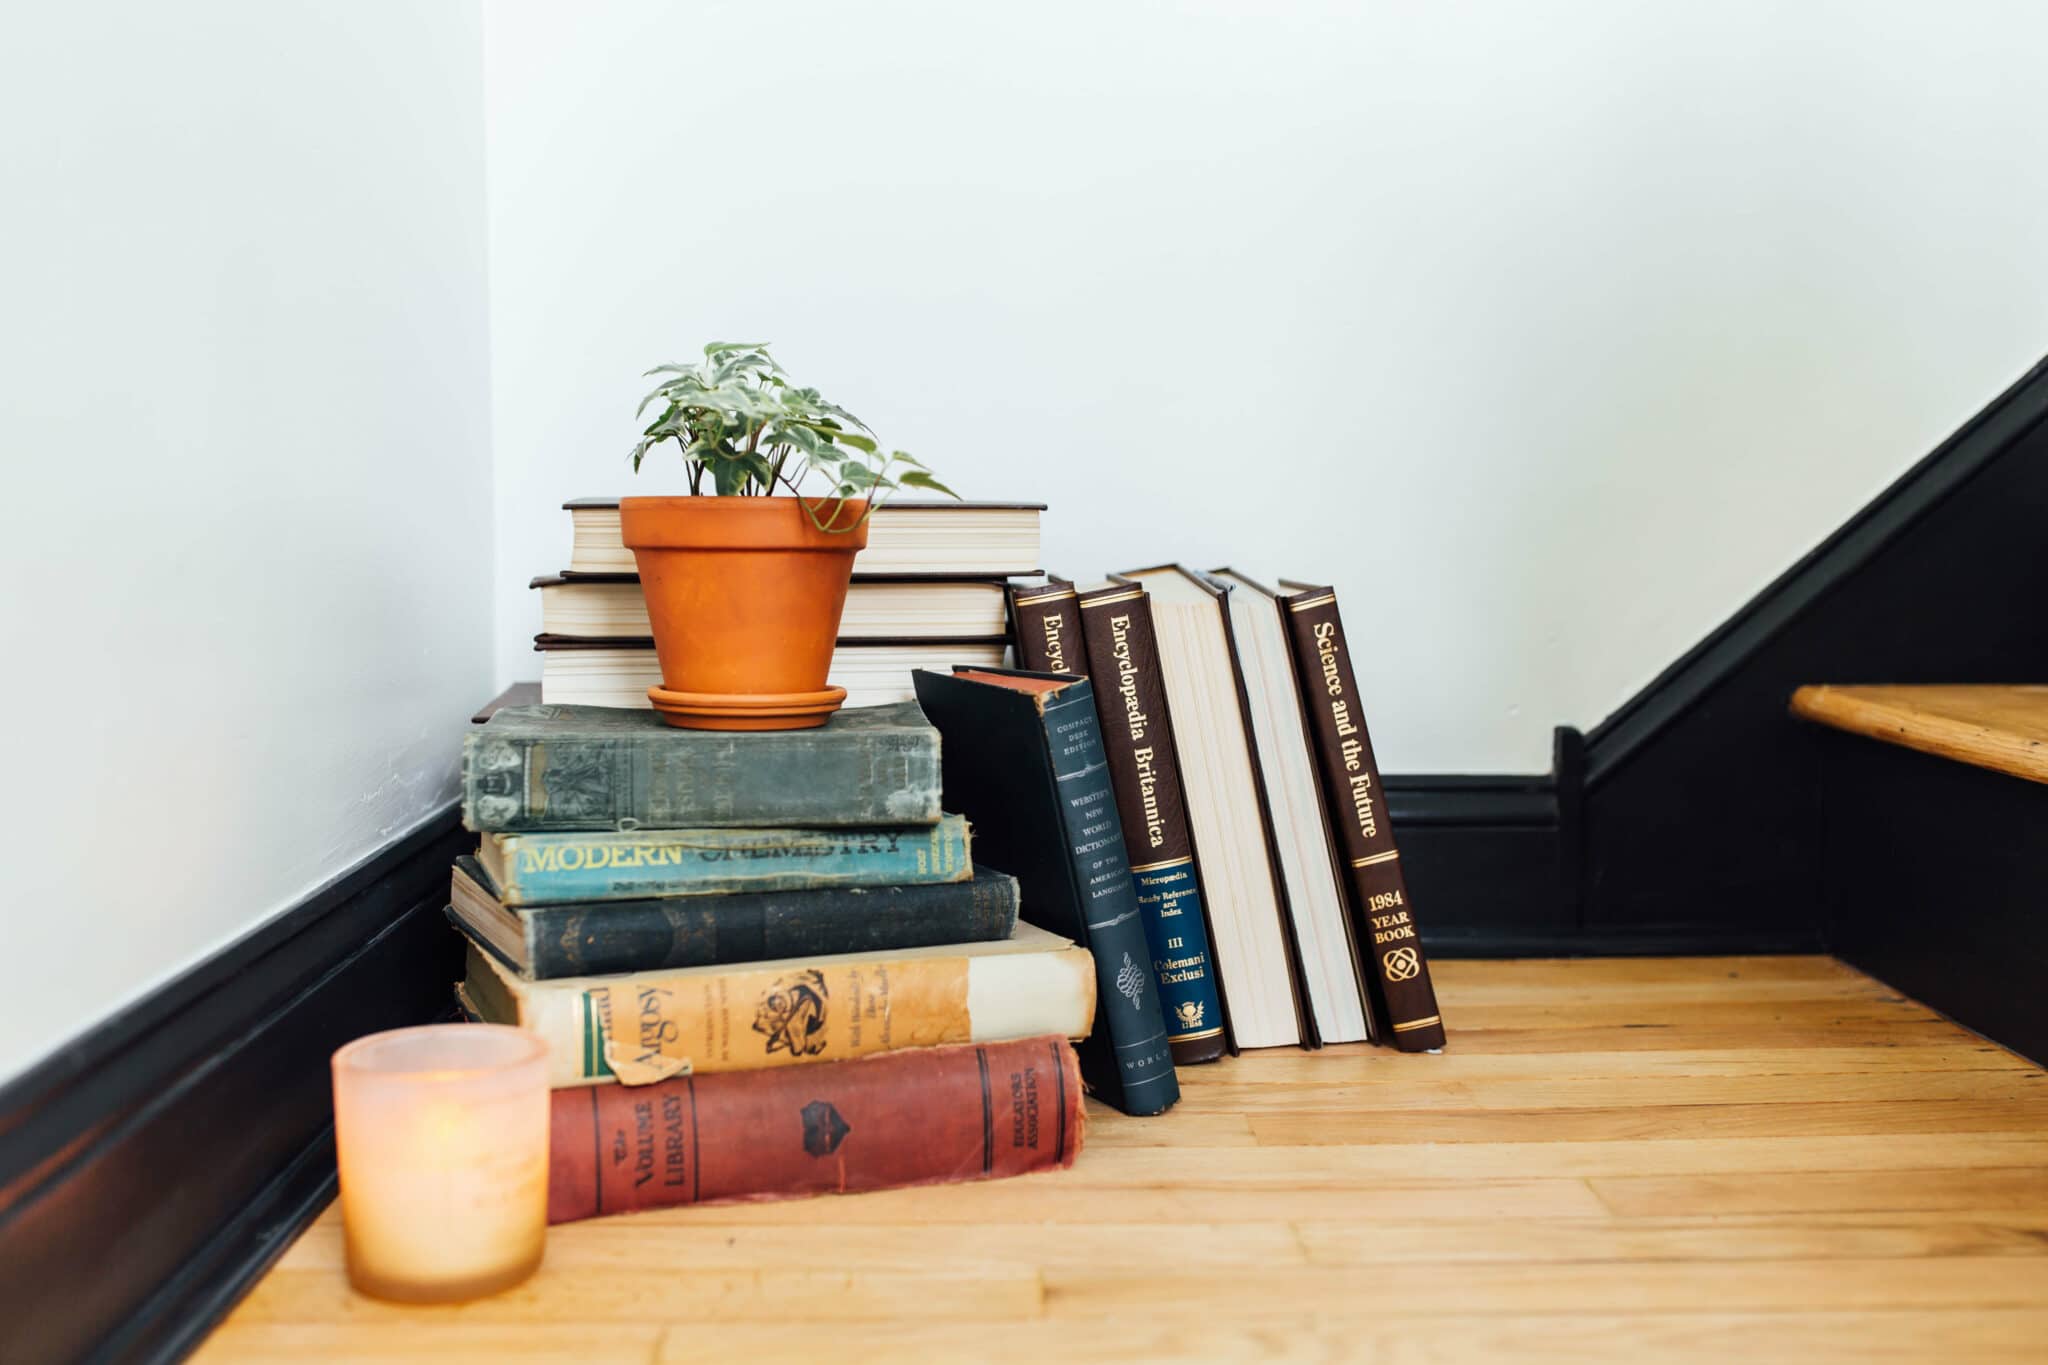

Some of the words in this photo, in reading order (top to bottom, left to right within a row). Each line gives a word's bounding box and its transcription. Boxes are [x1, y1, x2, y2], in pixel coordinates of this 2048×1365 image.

[1314, 622, 1342, 696] Science
[1057, 716, 1093, 733] COMPACT
[1332, 700, 1357, 736] and
[1111, 614, 1148, 741] Encyclopædia
[1134, 746, 1165, 847] Britannica
[1341, 734, 1362, 772] the
[1085, 808, 1104, 820] NEW
[1349, 771, 1377, 839] Future
[1083, 820, 1112, 836] WORLD
[524, 843, 683, 873] MODERN
[1093, 860, 1103, 870] OF
[1162, 899, 1177, 909] and
[1368, 889, 1404, 912] 1984
[1372, 911, 1410, 929] YEAR
[1168, 937, 1184, 949] III
[1375, 925, 1416, 944] BOOK
[1154, 952, 1205, 971] Colemani
[1160, 966, 1205, 984] Exclusi
[633, 985, 679, 1070] Argosy
[1025, 1068, 1038, 1148] ASSOCIATION
[635, 1101, 655, 1188] VOLUME
[663, 1094, 684, 1187] LIBRARY
